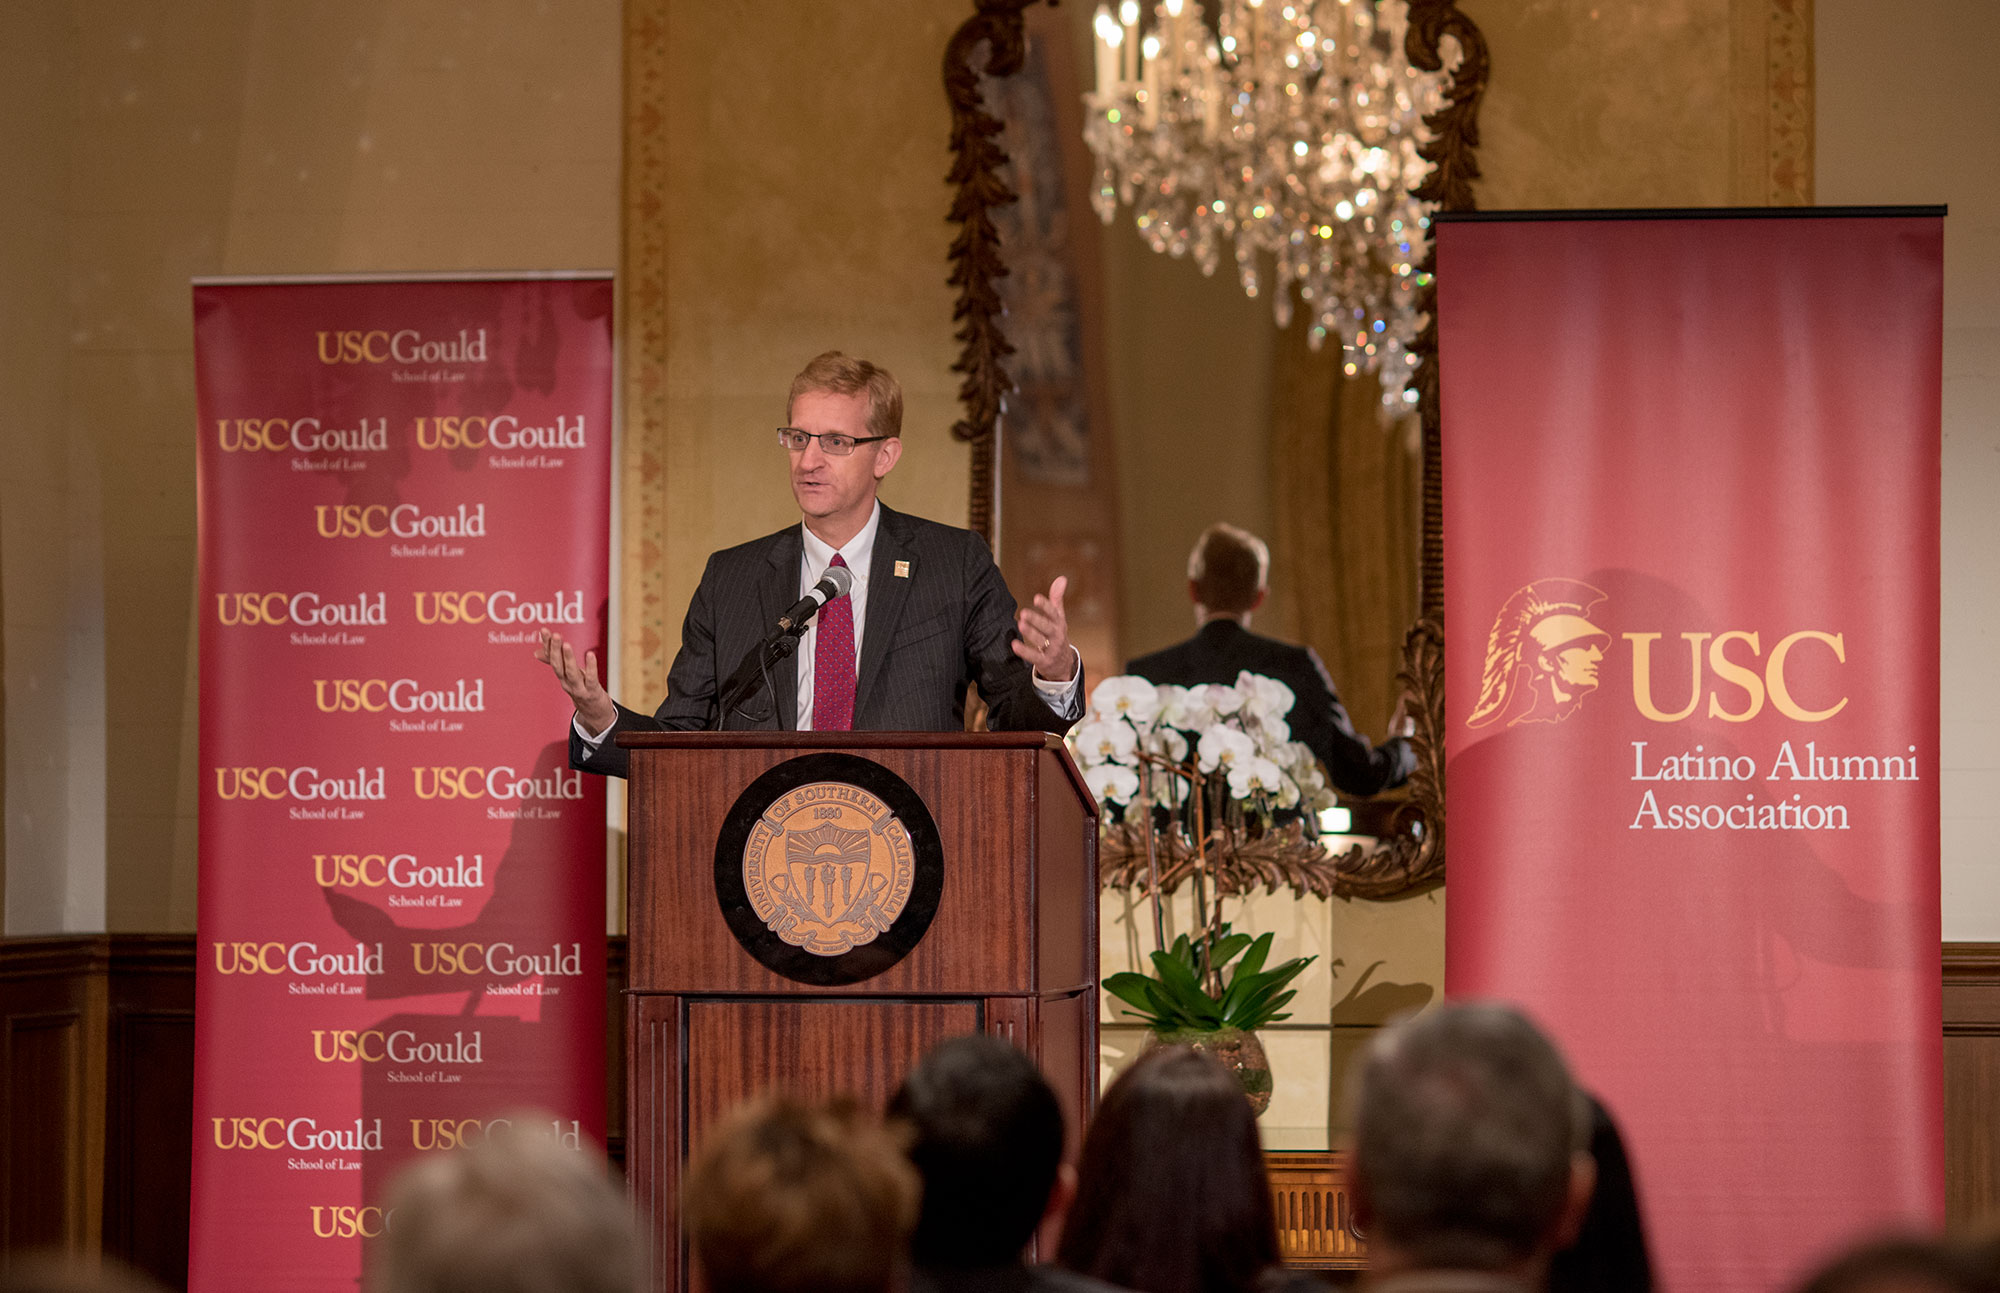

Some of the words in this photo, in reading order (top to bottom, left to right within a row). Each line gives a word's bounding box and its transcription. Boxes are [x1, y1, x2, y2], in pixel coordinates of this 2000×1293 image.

[391, 370, 428, 384] School
[428, 370, 441, 384] of
[442, 370, 467, 384] Law
[290, 458, 330, 472] School
[330, 458, 342, 472] of
[343, 458, 367, 472] Law
[488, 455, 526, 470] School
[526, 455, 539, 470] of
[540, 455, 564, 470] Law
[390, 544, 428, 558] School
[428, 544, 440, 558] of
[441, 544, 465, 558] Law
[289, 632, 328, 646] School
[328, 632, 341, 646] of
[342, 632, 366, 646] Law
[487, 630, 525, 645] School
[524, 630, 537, 645] of
[1622, 631, 1849, 722] USC
[389, 719, 426, 732] School
[427, 719, 439, 732] of
[440, 719, 464, 732] Law
[1631, 741, 1756, 781] Latino
[1766, 740, 1920, 781] Alumni
[289, 807, 327, 820] School
[327, 807, 339, 820] of
[340, 807, 365, 820] Law
[486, 807, 524, 820] School
[524, 807, 535, 820] of
[537, 807, 561, 820] Law
[813, 807, 843, 820] 1880
[1629, 789, 1851, 830] Association
[748, 826, 774, 915] UNIVERSITY
[773, 799, 791, 818] OF
[794, 786, 881, 816] SOUTHERN
[884, 824, 912, 914] CALIFORNIA
[388, 895, 425, 908] School
[426, 895, 439, 908] of
[440, 895, 463, 908] Law
[288, 983, 326, 996] School
[326, 983, 339, 996] of
[340, 983, 364, 996] Law
[485, 983, 523, 996] School
[523, 983, 536, 996] of
[537, 983, 560, 996] Law
[386, 1071, 424, 1084] School
[425, 1071, 437, 1084] of
[438, 1071, 462, 1084] Law
[287, 1157, 324, 1171] School
[325, 1157, 338, 1171] of
[339, 1157, 362, 1171] Law
